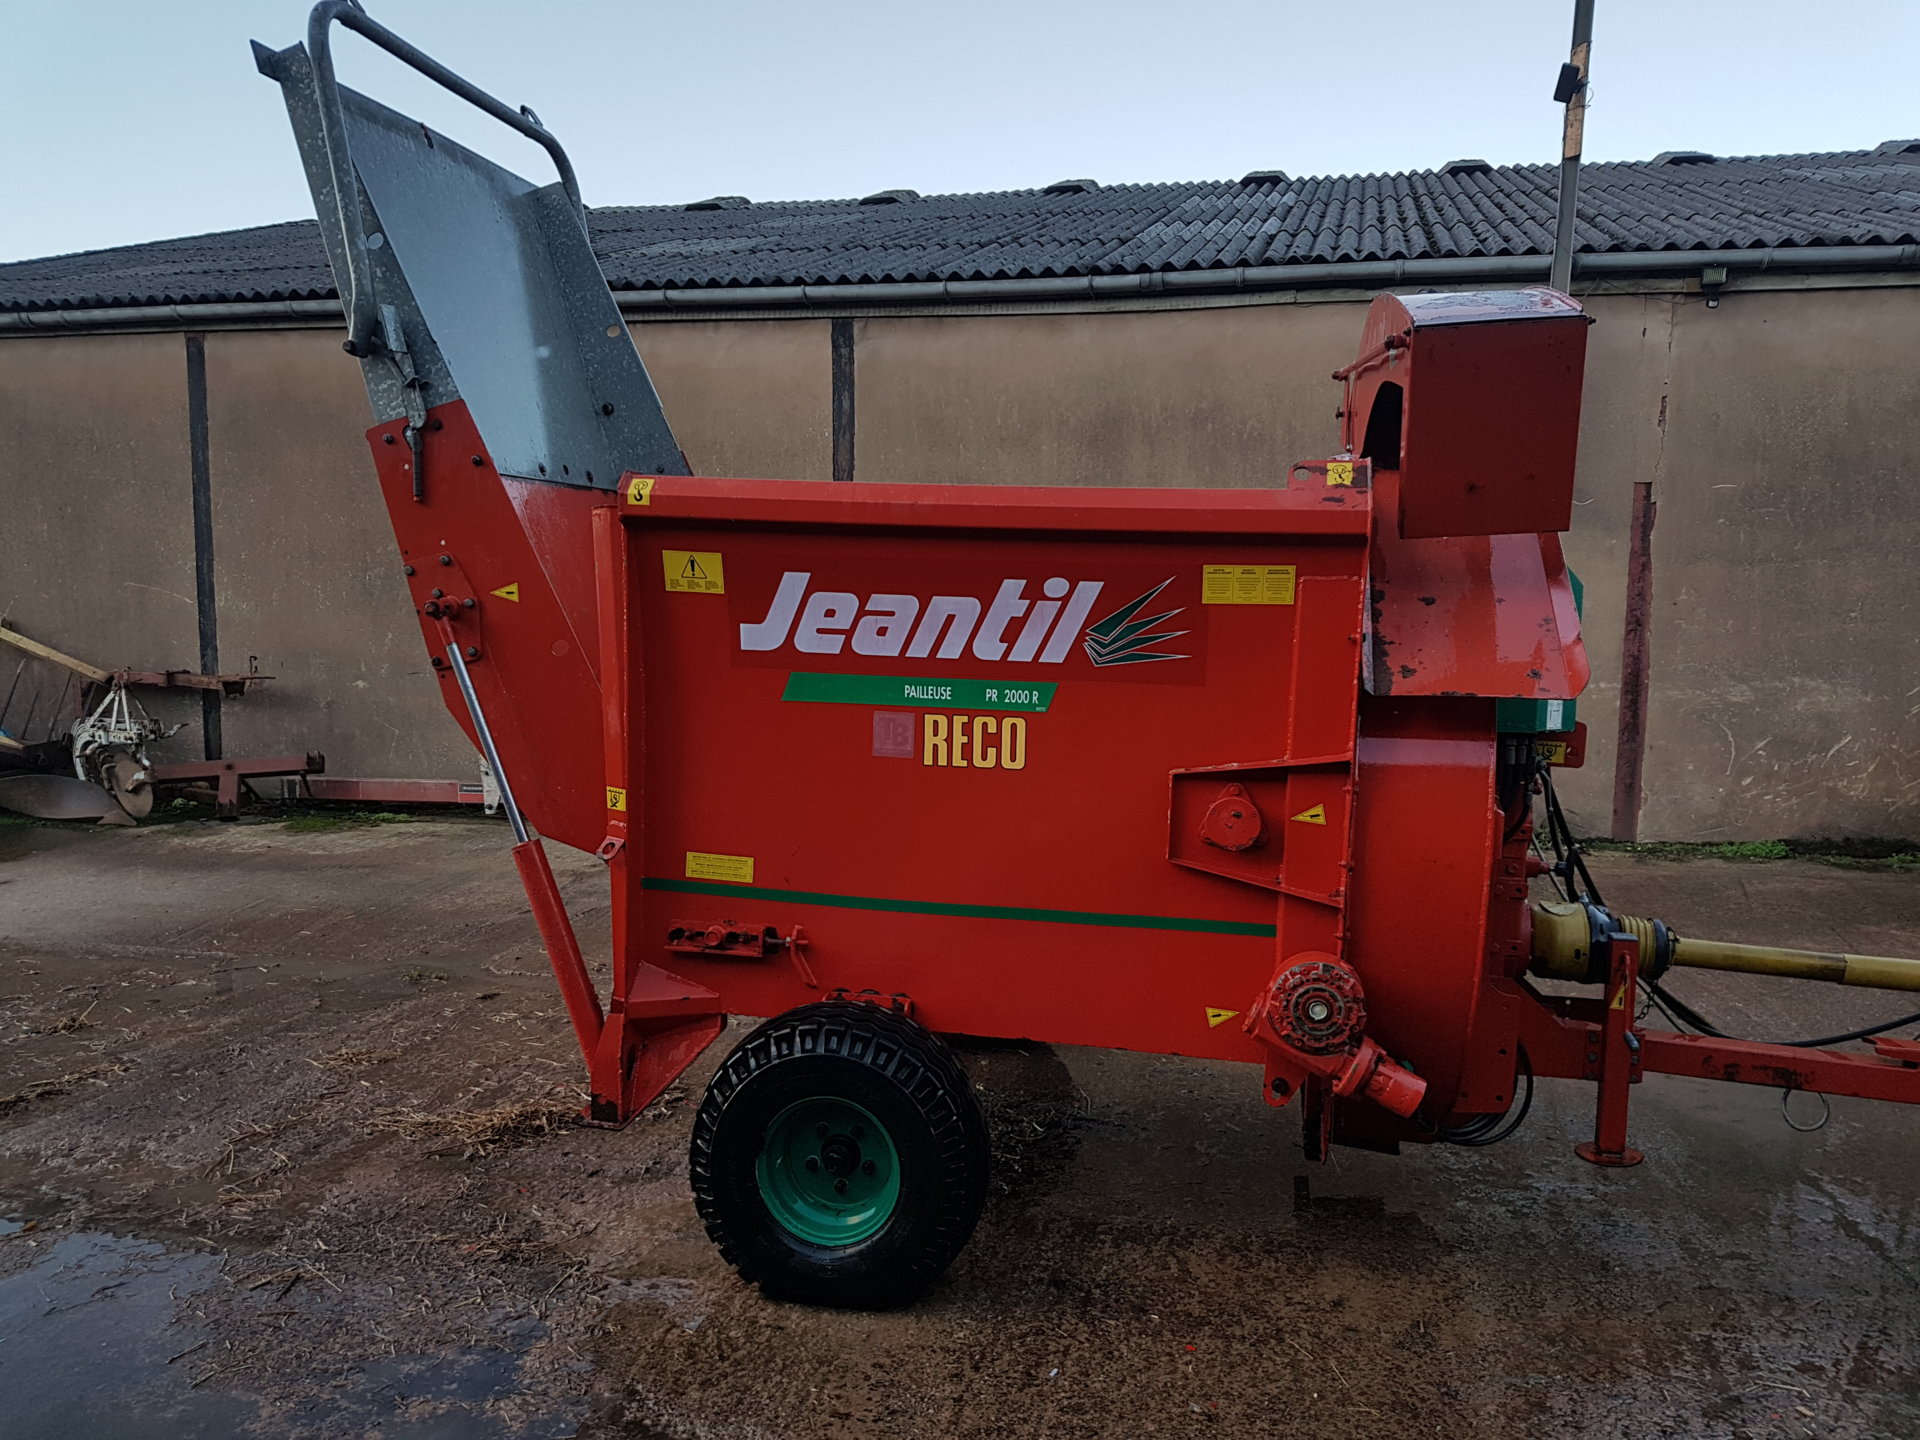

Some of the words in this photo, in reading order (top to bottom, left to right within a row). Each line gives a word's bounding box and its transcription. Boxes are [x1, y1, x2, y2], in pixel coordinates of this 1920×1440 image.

[739, 571, 1104, 664] Jeantil
[904, 685, 952, 700] PAILLEUSE
[985, 689, 998, 702] PR
[1004, 690, 1030, 704] 2000
[1032, 692, 1039, 704] R
[923, 713, 1027, 770] RECO
